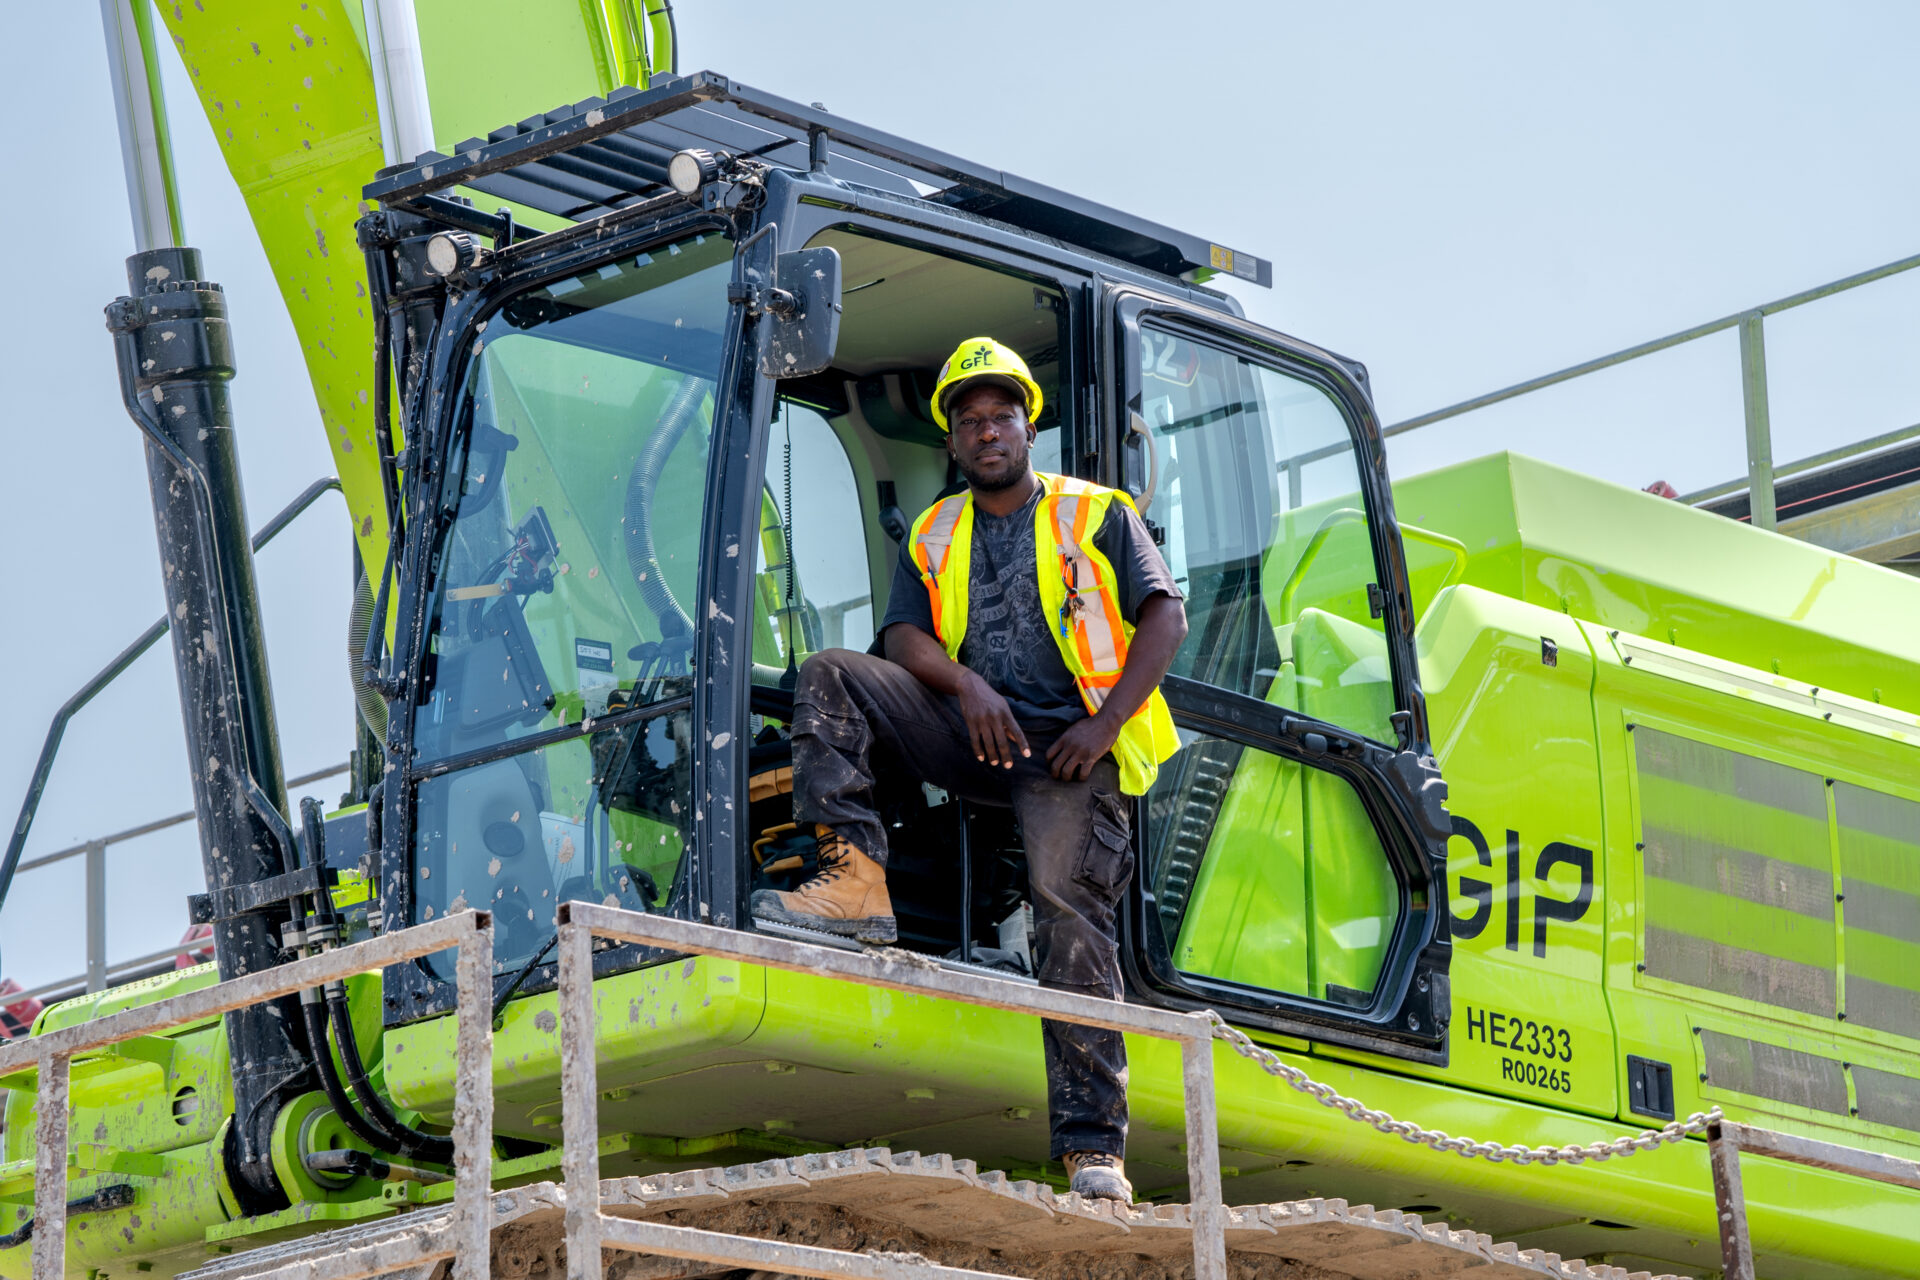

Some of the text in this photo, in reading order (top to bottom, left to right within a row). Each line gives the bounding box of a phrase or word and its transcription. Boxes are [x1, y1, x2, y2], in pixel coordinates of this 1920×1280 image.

[961, 351, 992, 370] GFL
[1447, 815, 1593, 959] GIP
[1467, 1006, 1572, 1062] HE2333
[1502, 1057, 1571, 1093] R00265
